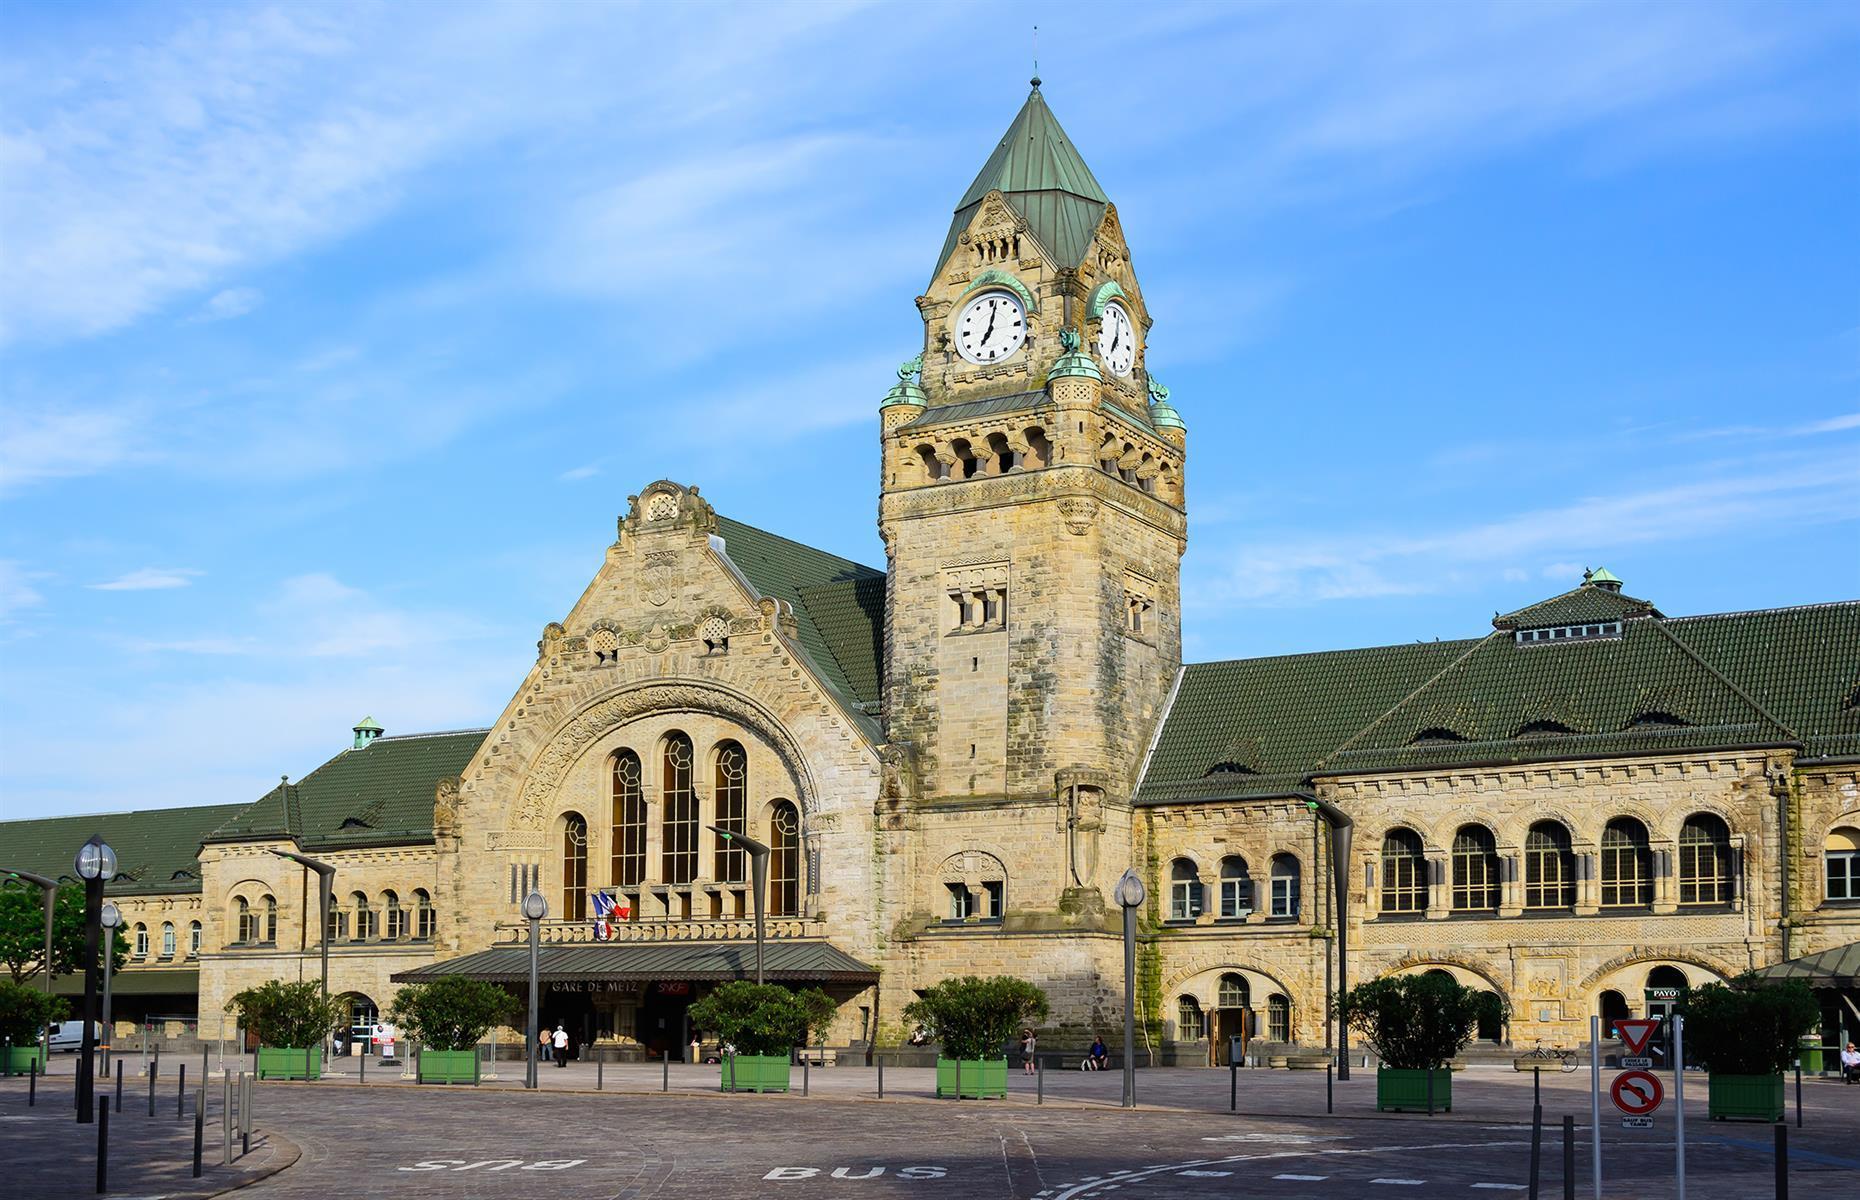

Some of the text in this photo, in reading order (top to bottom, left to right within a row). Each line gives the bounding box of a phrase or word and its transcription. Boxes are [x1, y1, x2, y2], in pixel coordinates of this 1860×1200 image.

[552, 982, 639, 992] GARE DE METZ
[658, 982, 685, 993] SNCF
[397, 1159, 588, 1171] BUS
[762, 1166, 949, 1180] BUS
